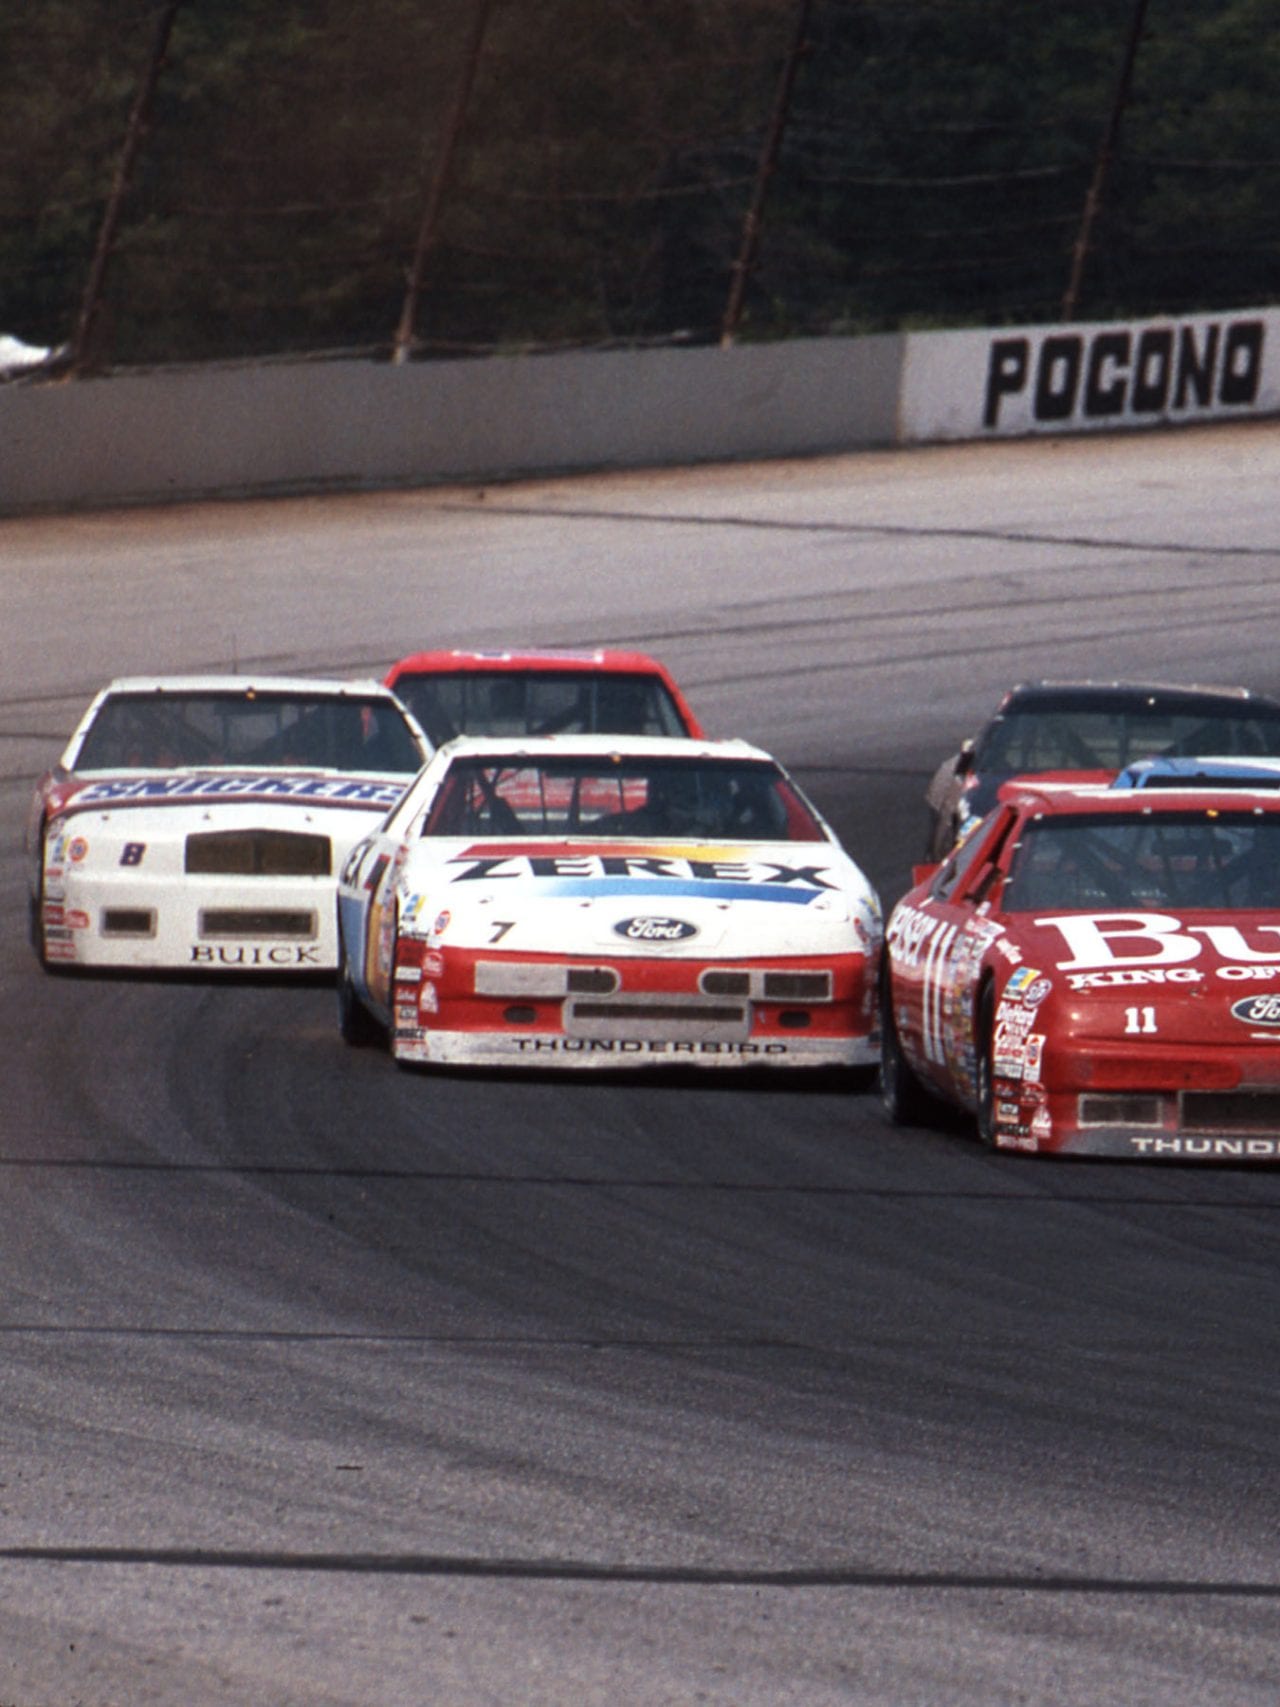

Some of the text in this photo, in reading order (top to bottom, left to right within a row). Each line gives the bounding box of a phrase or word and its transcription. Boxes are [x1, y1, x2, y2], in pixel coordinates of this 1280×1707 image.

[984, 320, 1265, 428] POCONO
[80, 777, 407, 800] SNICKERS
[120, 842, 147, 866] 8
[446, 857, 840, 891] ZEREX
[489, 922, 516, 943] 7
[626, 917, 687, 941] Ford
[189, 945, 322, 964] BUICK
[1066, 968, 1205, 990] KING
[1123, 1007, 1157, 1033] 11
[512, 1038, 788, 1055] THUNDERBIRD
